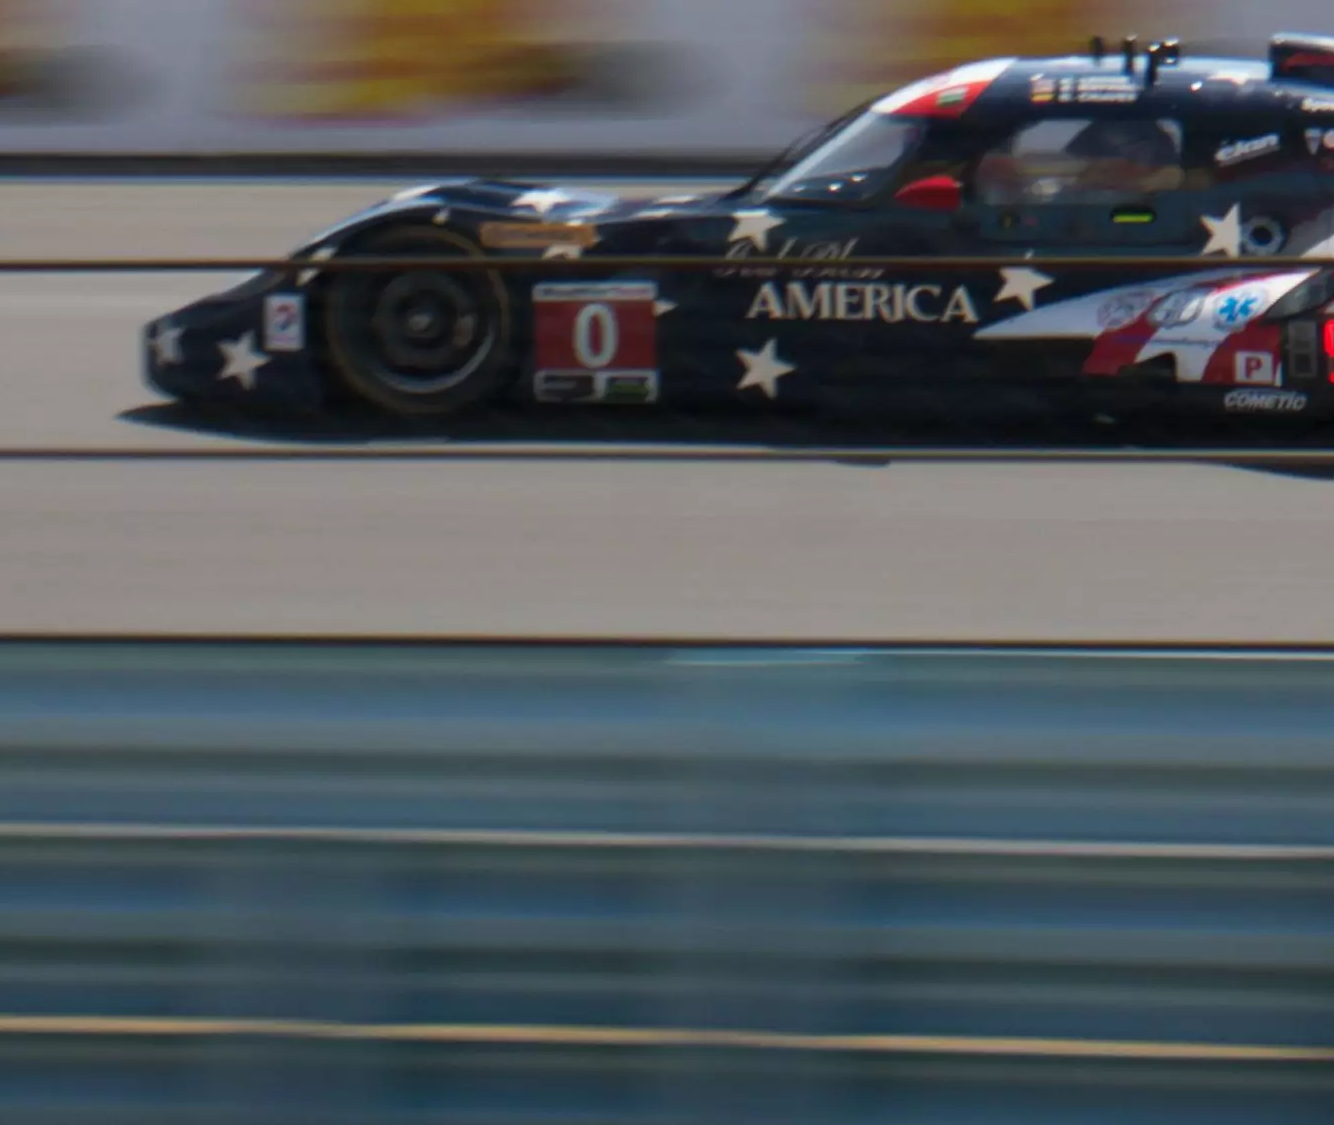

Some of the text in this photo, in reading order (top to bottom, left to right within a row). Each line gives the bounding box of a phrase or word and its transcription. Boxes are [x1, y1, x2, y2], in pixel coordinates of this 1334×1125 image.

[744, 280, 979, 323] AMERICA
[572, 303, 619, 370] 0
[1245, 355, 1264, 379] P
[1223, 391, 1309, 411] COMETIC
